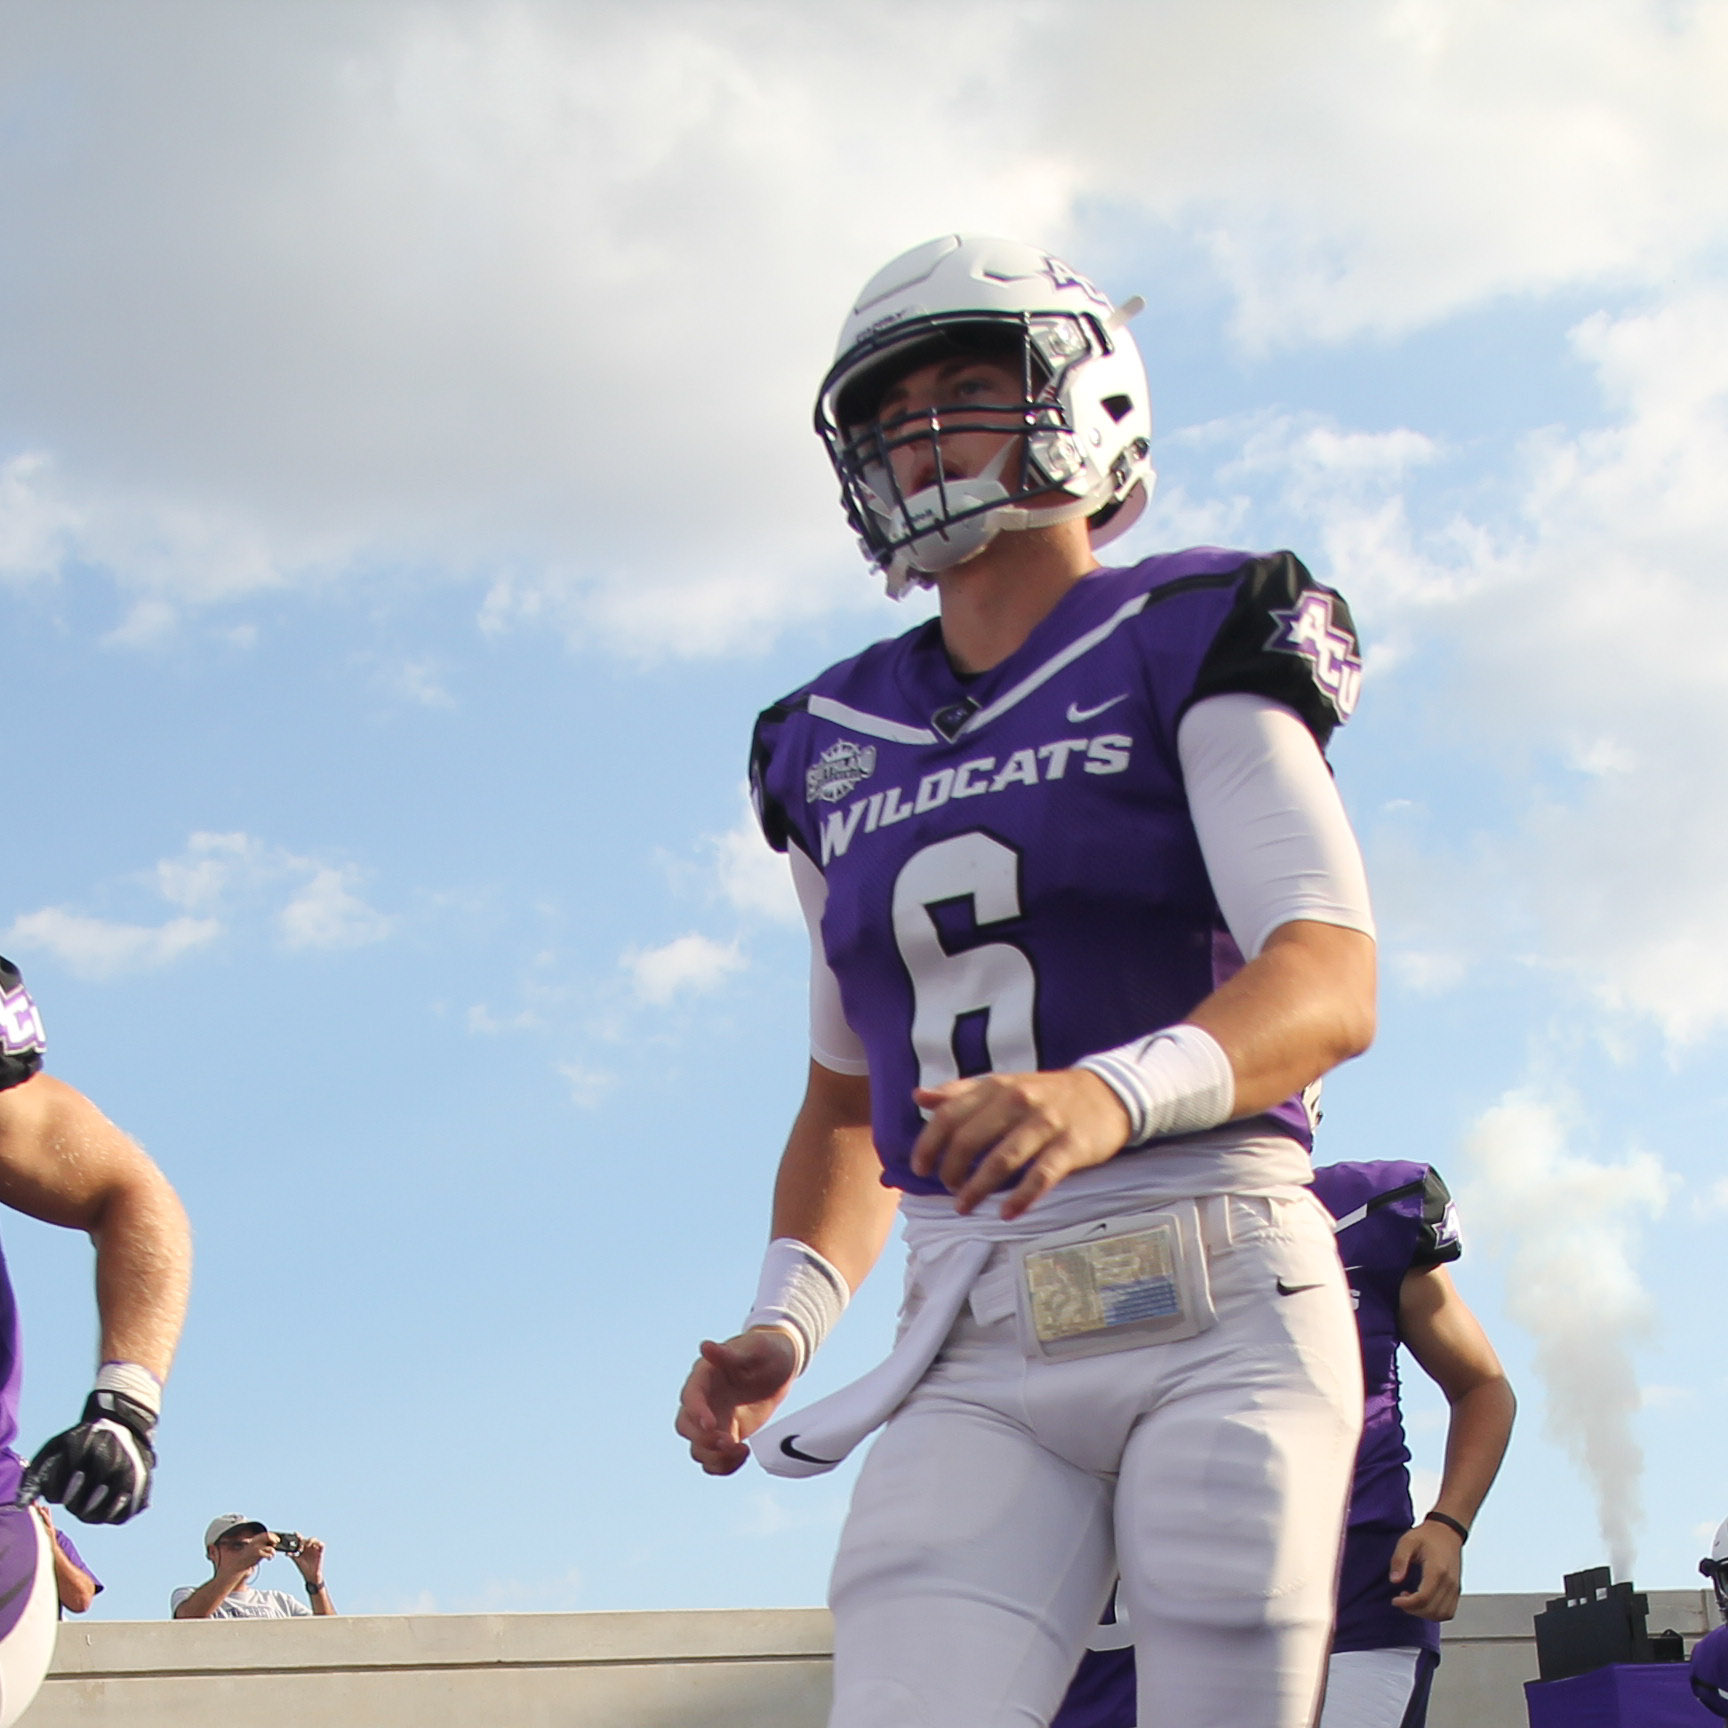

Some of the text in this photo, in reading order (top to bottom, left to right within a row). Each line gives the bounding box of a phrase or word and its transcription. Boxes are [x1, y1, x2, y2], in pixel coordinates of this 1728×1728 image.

[1286, 602, 1361, 718] ACU
[821, 733, 1134, 867] WILDCATS
[892, 831, 1039, 1125] 6
